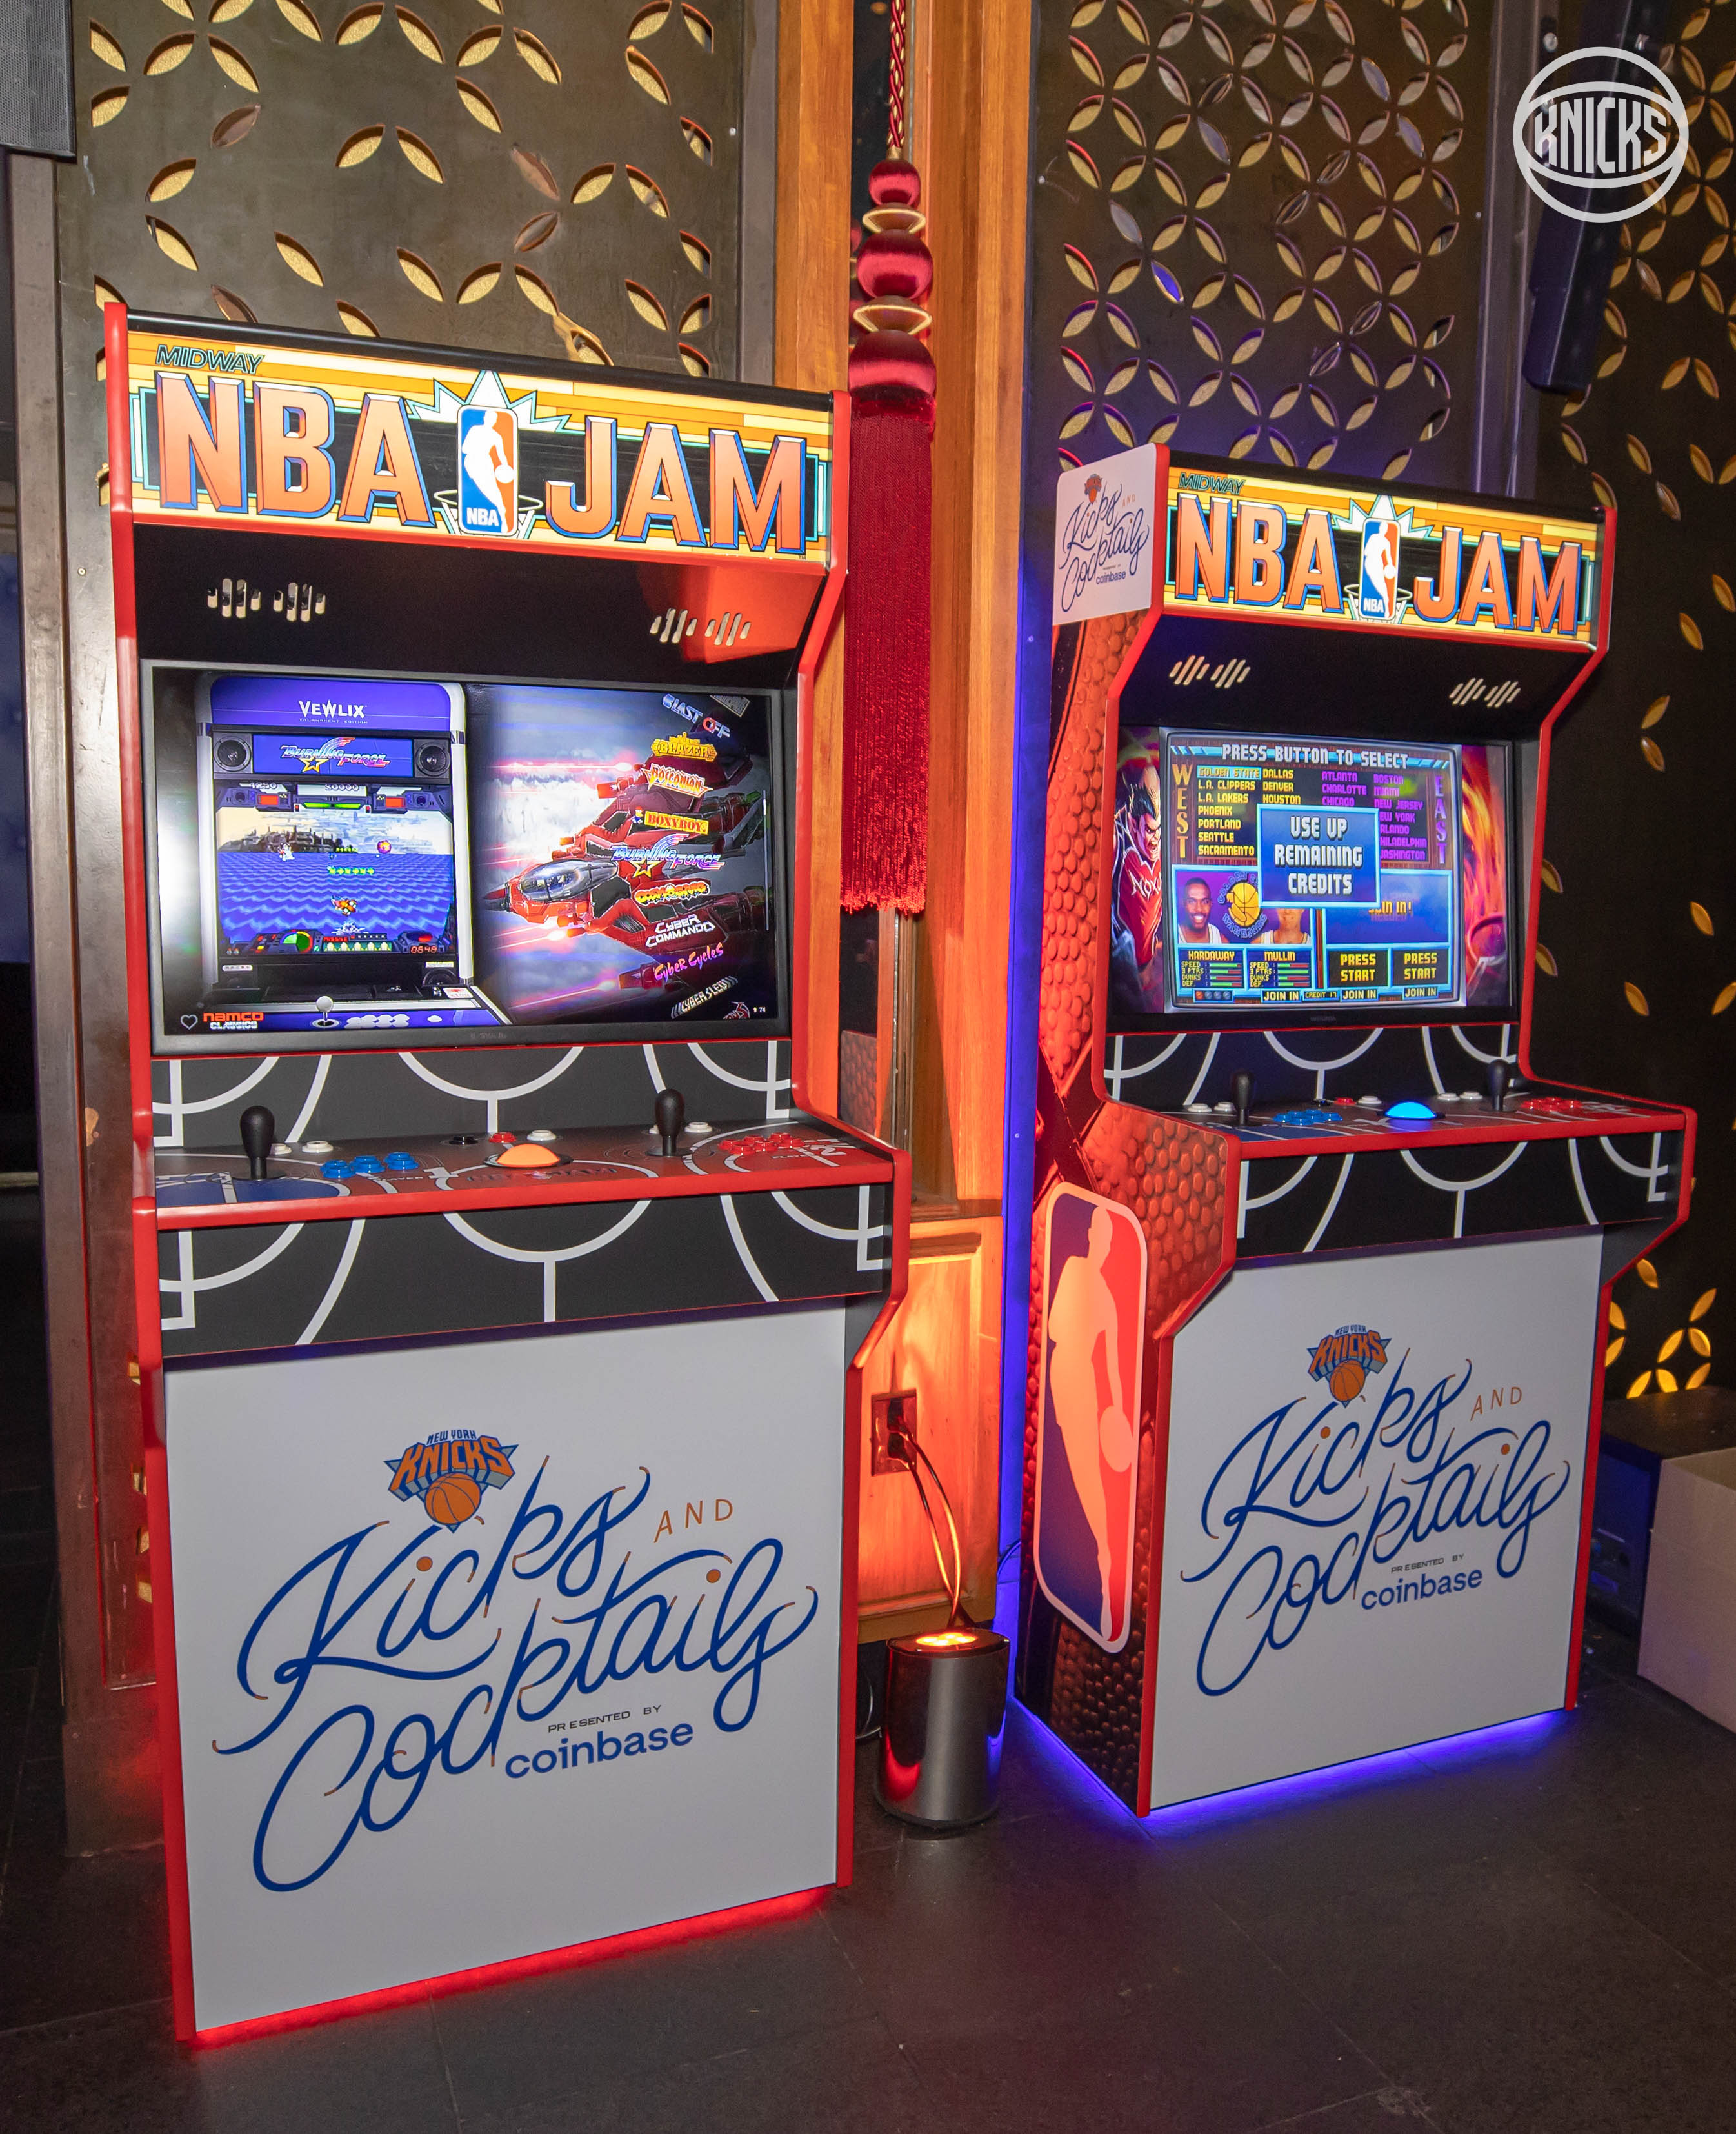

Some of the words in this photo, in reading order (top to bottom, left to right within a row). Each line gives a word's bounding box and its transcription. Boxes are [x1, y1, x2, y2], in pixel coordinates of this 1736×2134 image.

[156, 344, 265, 374] MIDWAY
[154, 370, 439, 528] NBA
[544, 415, 806, 555] JAM
[1178, 472, 1246, 495] MIDWAY
[466, 507, 499, 526] NBA
[1174, 492, 1344, 614] NBA
[1414, 526, 1584, 635] JAM
[1096, 571, 1126, 584] coinbase
[1363, 597, 1384, 613] NBA
[662, 693, 703, 724] BLAST
[703, 717, 730, 738] OFF
[659, 741, 708, 757] BLAZER
[1222, 744, 1267, 761] PRESS
[1275, 746, 1329, 764] BUTTON
[1336, 749, 1353, 766] TO
[1361, 751, 1408, 769] SELECT
[1199, 767, 1230, 777] GOLDEN
[1233, 768, 1260, 778] STATE
[1262, 768, 1293, 779] DALLAS
[1322, 771, 1357, 782] ATLANTA
[1198, 779, 1214, 790] L.A.
[1217, 780, 1255, 791] CLIPPERS
[1373, 774, 1404, 785] BOSTON
[1262, 781, 1293, 792] DENVER
[1322, 784, 1366, 795] CHARLOTTE
[1373, 786, 1399, 797] MIAMI
[1198, 792, 1214, 803] L.A.
[1217, 793, 1248, 803] LAKERS
[1262, 794, 1301, 804] HOUSTON
[1322, 796, 1355, 806] CHICAGO
[1172, 763, 1193, 858] WEST
[1198, 806, 1233, 816] PHOENIX
[1374, 799, 1392, 809] NEW
[1395, 800, 1423, 810] JERSEY
[1380, 812, 1392, 821] EW
[1395, 812, 1415, 823] YORK
[1434, 776, 1446, 864] EAST
[1198, 819, 1241, 830] PORTLAND
[1290, 816, 1320, 839] USE
[1326, 818, 1348, 840] UP
[1380, 824, 1410, 835] RLANDO
[1198, 832, 1234, 843] SEATTLE
[1380, 837, 1427, 848] HILADELPHIA
[610, 840, 680, 861] BURNING
[670, 854, 725, 870] FORCE
[1198, 845, 1254, 856] SACRAMENTO
[1274, 844, 1363, 868] REMAINING
[1288, 873, 1352, 895] CREDITS
[1368, 901, 1392, 914] IN
[655, 914, 701, 933] CYBER
[646, 921, 715, 948] COMMANDO
[1188, 951, 1235, 961] HARDAWAY
[1264, 951, 1295, 961] MULLIN
[1340, 953, 1376, 965] PRESS
[1404, 952, 1437, 964] PRESS
[1341, 969, 1375, 982] START
[1404, 968, 1436, 980] START
[681, 991, 708, 1013] CYBER
[706, 979, 728, 999] SLED
[1264, 991, 1286, 1001] JOIN
[1289, 991, 1299, 1001] IN
[1342, 990, 1364, 999] JOIN
[1367, 990, 1376, 998] IN
[1405, 988, 1425, 997] JOIN
[1428, 988, 1436, 996] IN
[203, 1012, 264, 1022] namco
[1335, 1326, 1349, 1336] NEW
[1350, 1324, 1366, 1333] YORK
[1308, 1330, 1388, 1375] KNICKS
[1470, 1386, 1523, 1421] AND
[426, 1430, 448, 1445] NEW
[450, 1429, 477, 1440] YORK
[388, 1435, 515, 1497] KNICKS
[653, 1498, 734, 1543] AND
[1391, 1558, 1444, 1574] PRESENTED
[1452, 1553, 1464, 1562] BY
[1361, 1570, 1482, 1610] coinbase
[548, 1711, 630, 1733] PRESENTED
[643, 1705, 661, 1715] BY
[505, 1723, 693, 1779] coinbase
